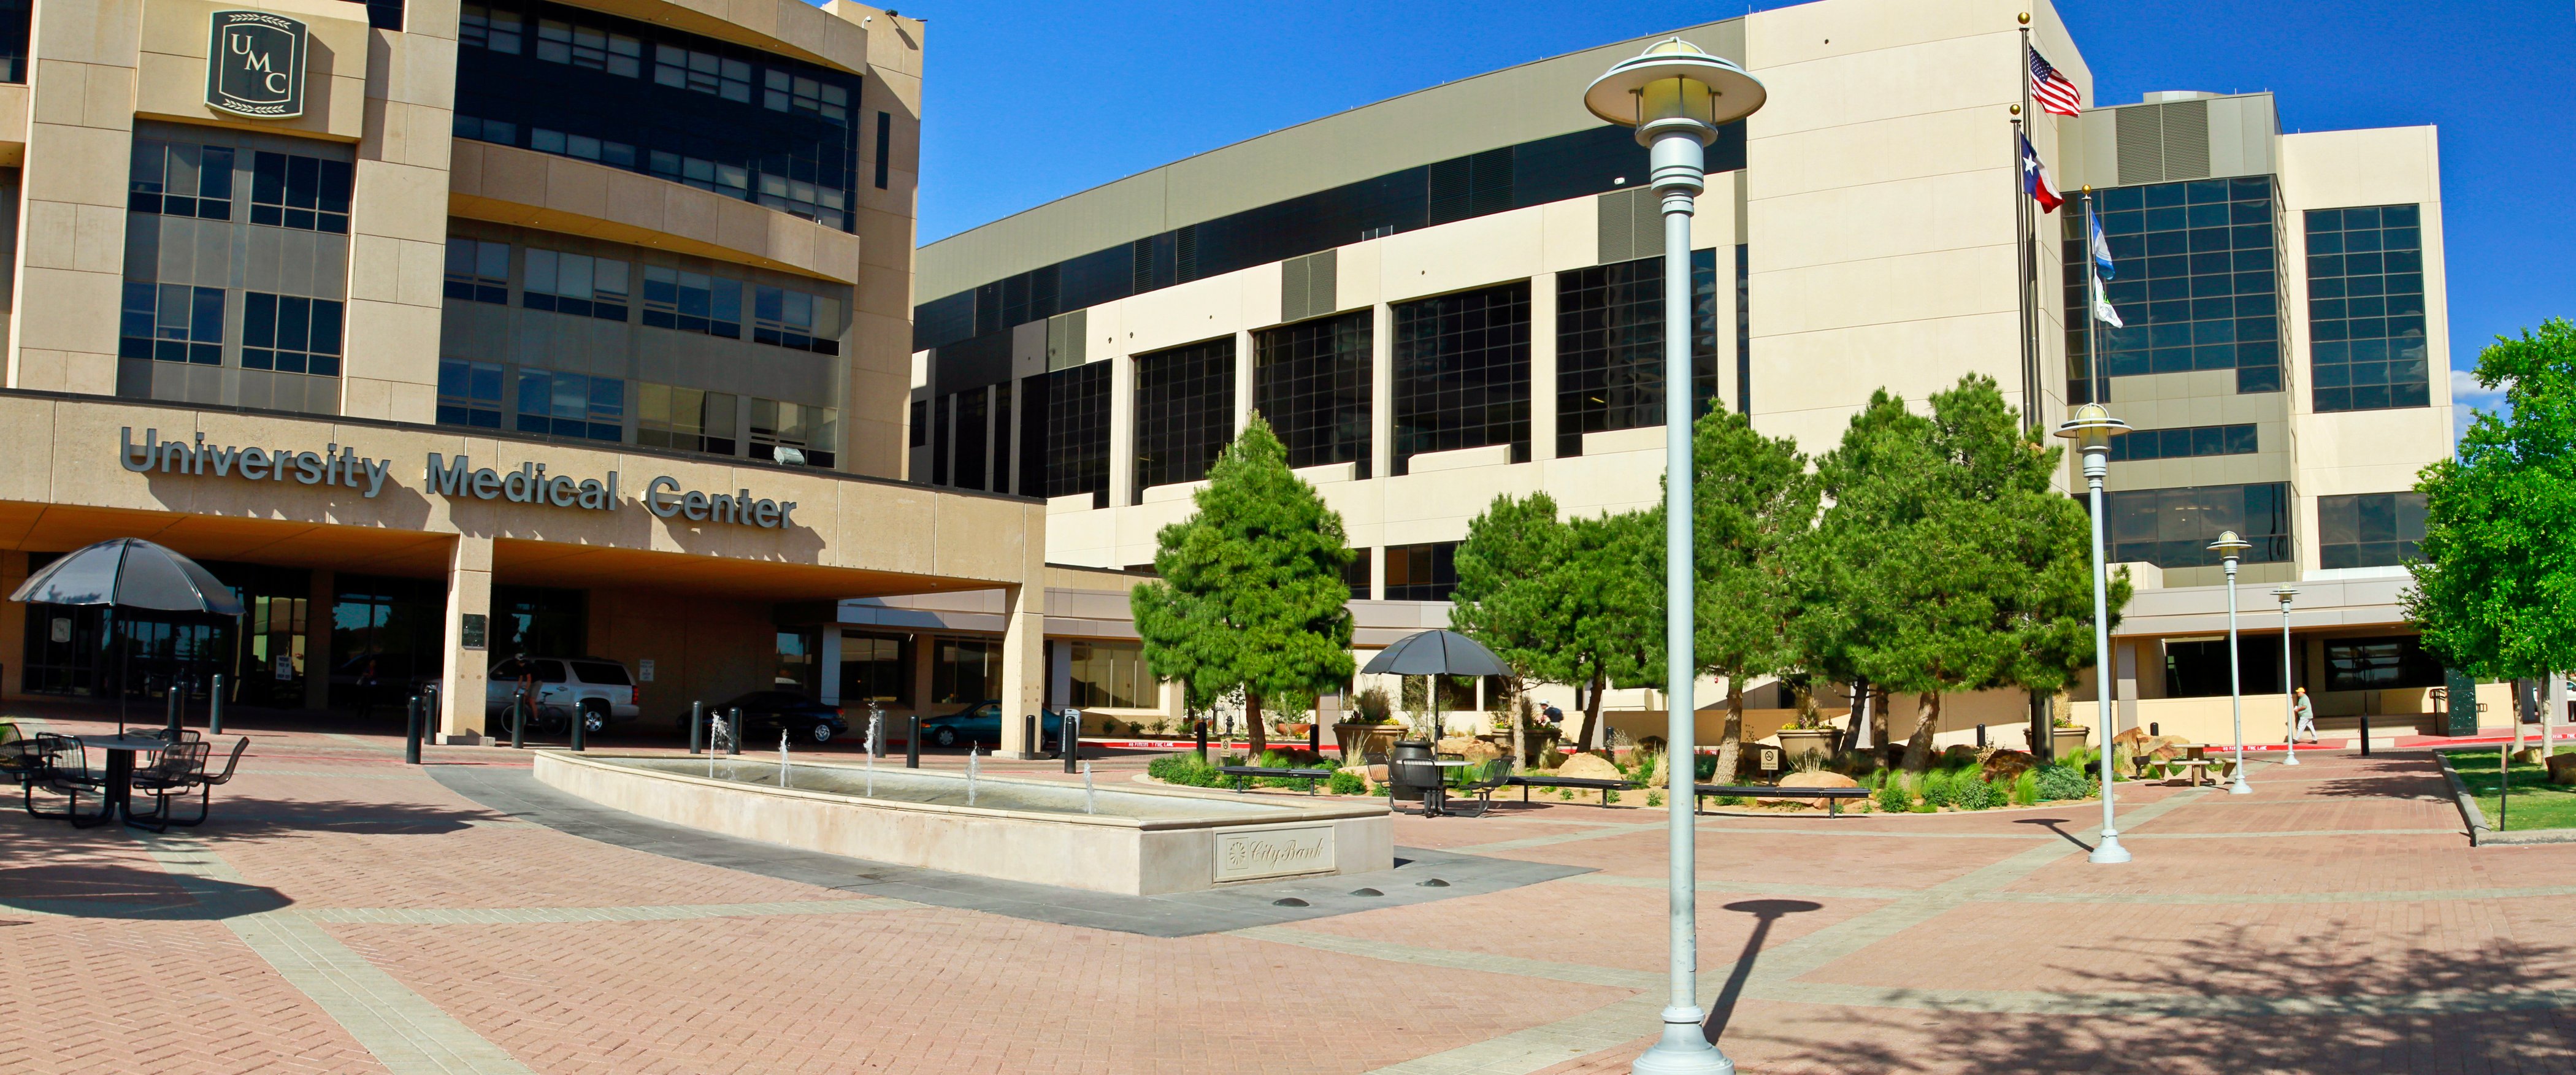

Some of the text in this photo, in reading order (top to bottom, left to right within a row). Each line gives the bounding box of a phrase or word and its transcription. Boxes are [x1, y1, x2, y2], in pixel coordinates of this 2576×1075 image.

[231, 33, 286, 94] UMC
[121, 427, 797, 529] University Medical Center
